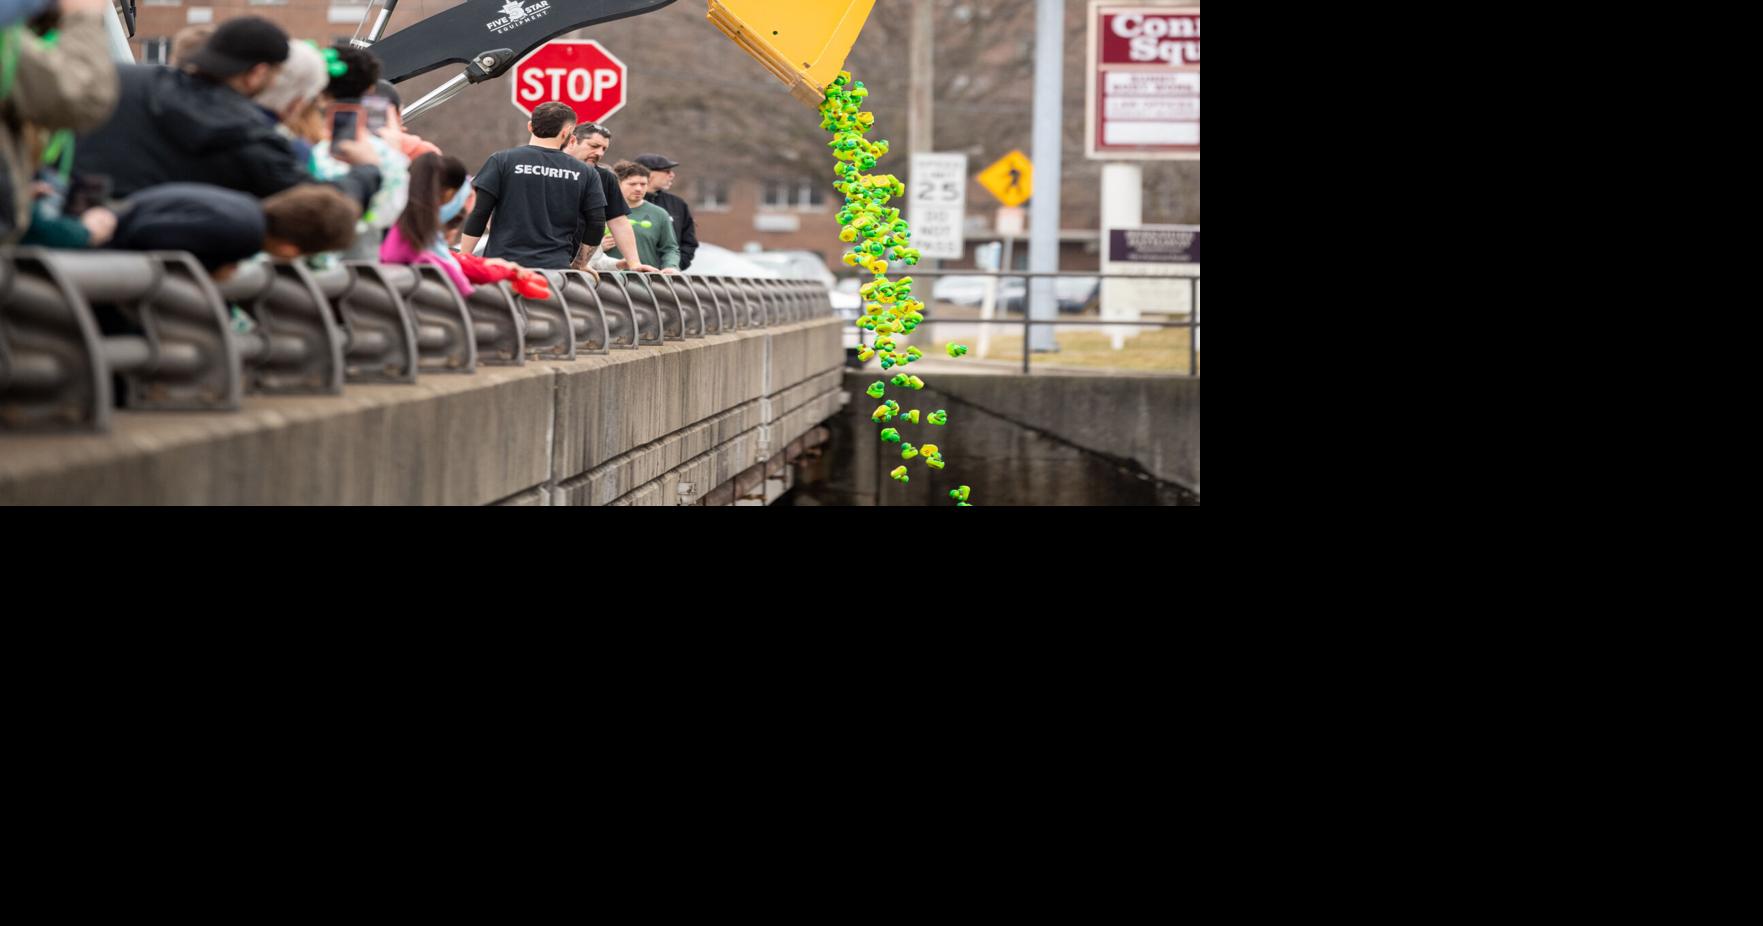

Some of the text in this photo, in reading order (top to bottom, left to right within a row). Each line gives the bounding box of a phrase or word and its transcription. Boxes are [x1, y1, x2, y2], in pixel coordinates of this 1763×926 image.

[486, 16, 509, 30] FIVE
[524, 0, 549, 14] STAR
[497, 10, 547, 34] EQUIPMENT
[520, 67, 618, 102] STOP
[514, 164, 581, 181] SECURITY
[917, 181, 962, 202] 25
